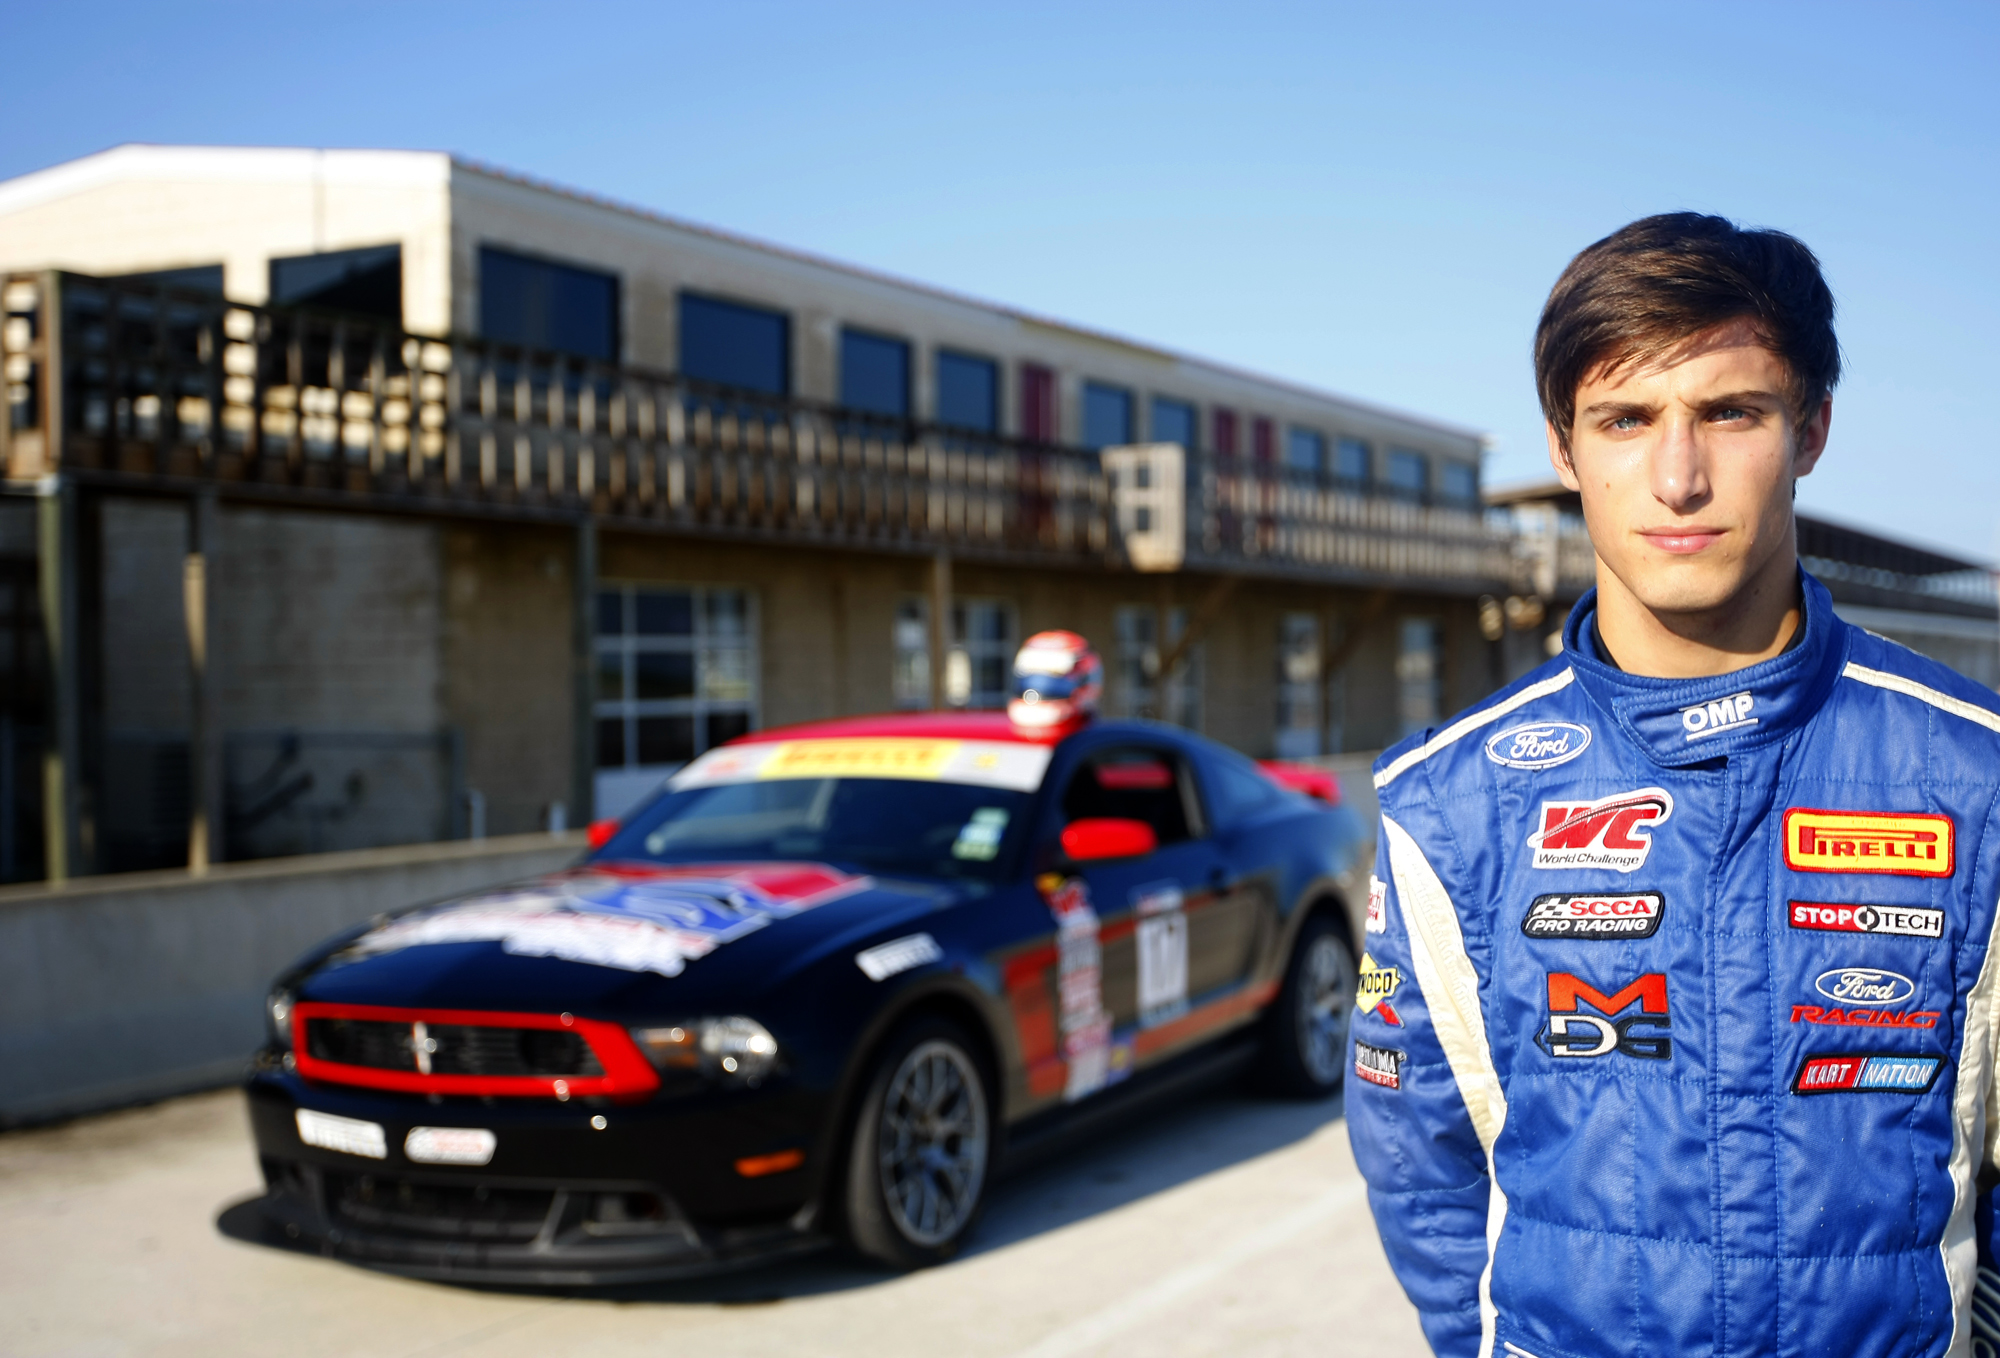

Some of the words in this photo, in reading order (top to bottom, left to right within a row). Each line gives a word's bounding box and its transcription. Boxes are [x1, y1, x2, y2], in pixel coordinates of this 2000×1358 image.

[1682, 694, 1754, 732] OMP
[1510, 728, 1569, 759] Ford
[1542, 805, 1659, 850] WC
[1798, 825, 1939, 861] PIRELLI
[1538, 853, 1576, 865] World
[1577, 853, 1639, 867] Challenge
[1570, 899, 1652, 917] SCCA
[1531, 919, 1571, 933] PRO
[1573, 918, 1649, 933] RACING
[1833, 971, 1898, 1000] Ford
[1789, 1004, 1942, 1030] RACING
[1805, 1063, 1853, 1085] KART
[1864, 1063, 1935, 1085] NATION
